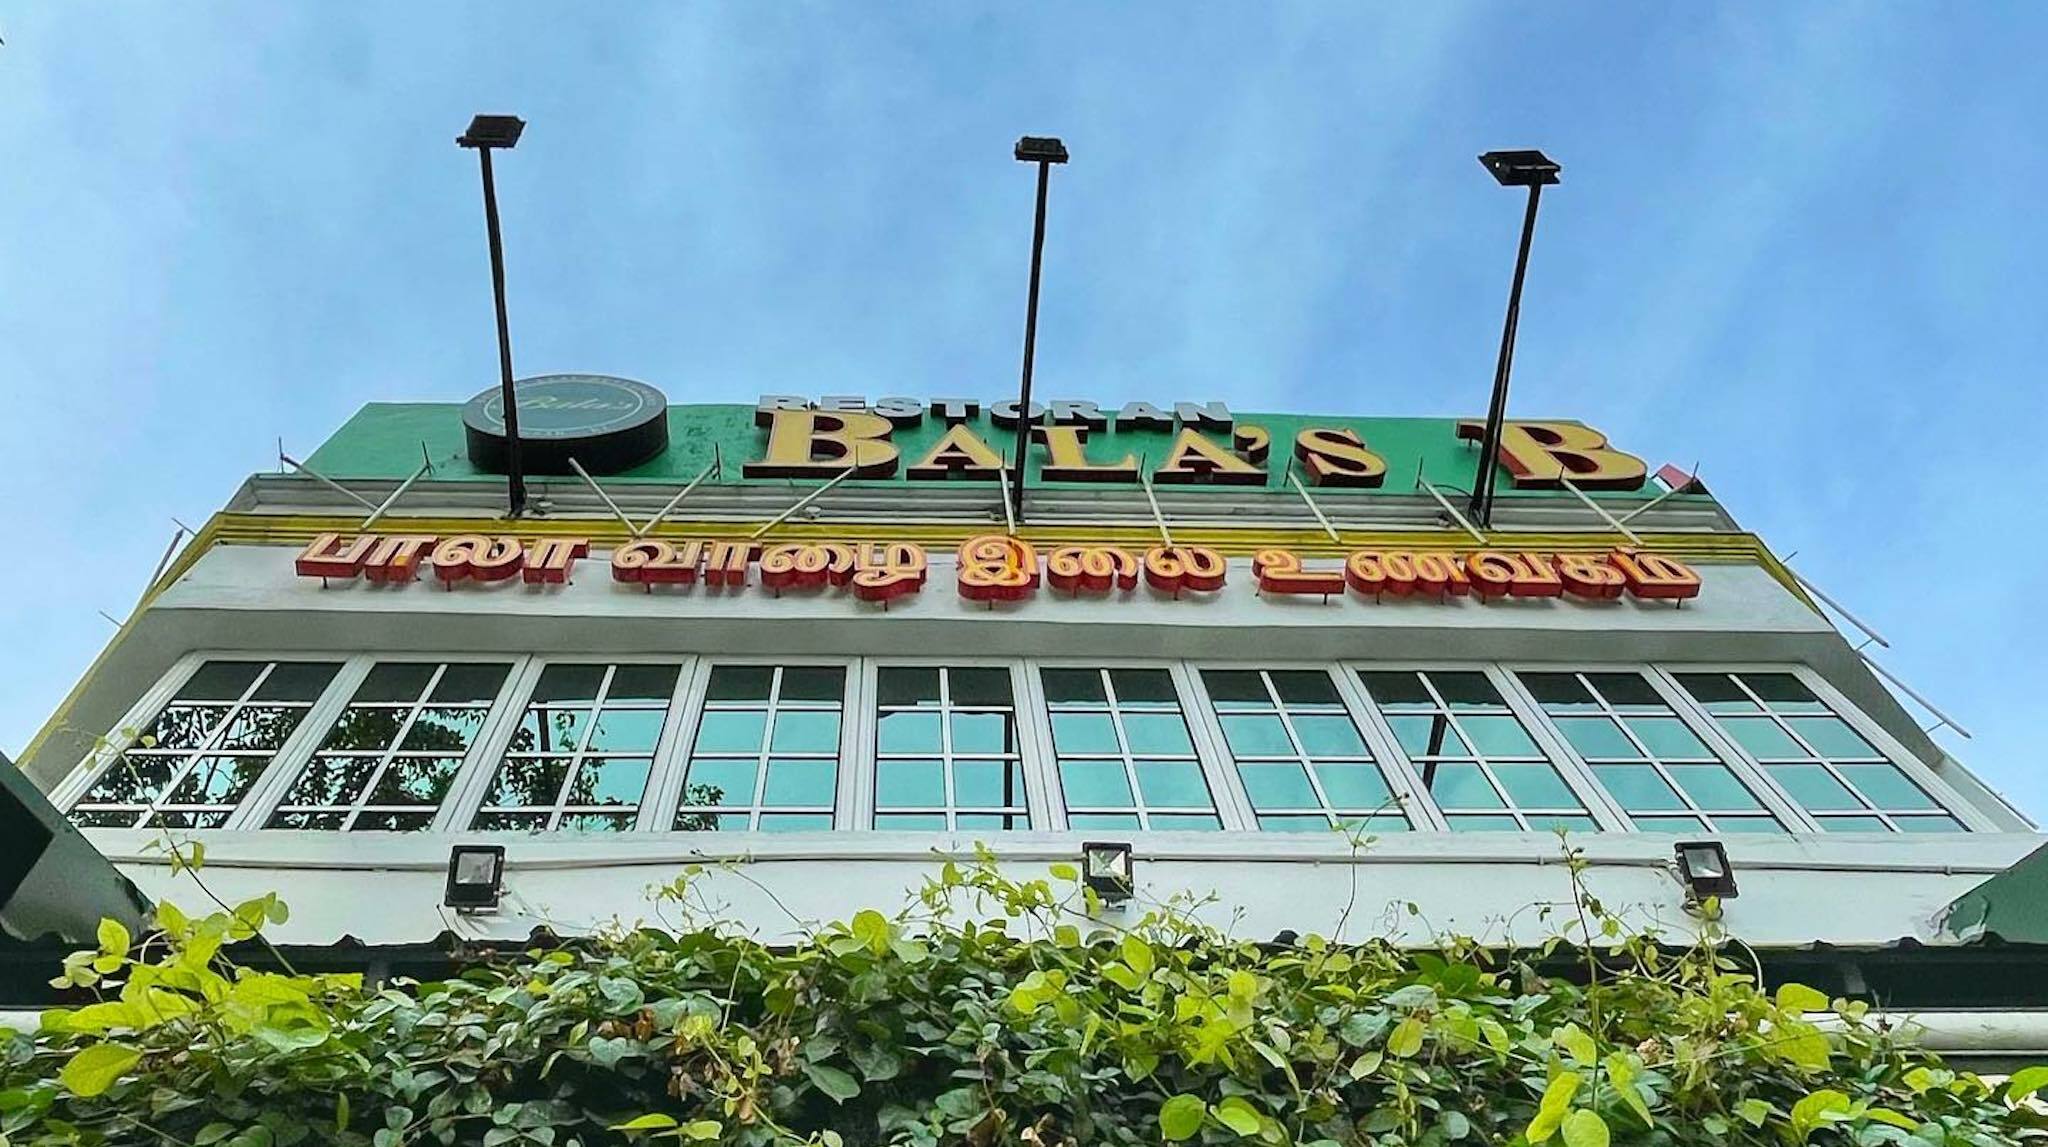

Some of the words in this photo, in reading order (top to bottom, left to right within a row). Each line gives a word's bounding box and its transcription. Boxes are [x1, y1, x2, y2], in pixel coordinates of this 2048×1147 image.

[743, 408, 1388, 486] BALA'S
[757, 394, 1233, 430] RESTORAN
[296, 531, 590, 584] பாலா
[612, 539, 927, 601] வாழை
[957, 535, 1227, 601] இலை
[1252, 545, 1701, 601] உணவகம்
